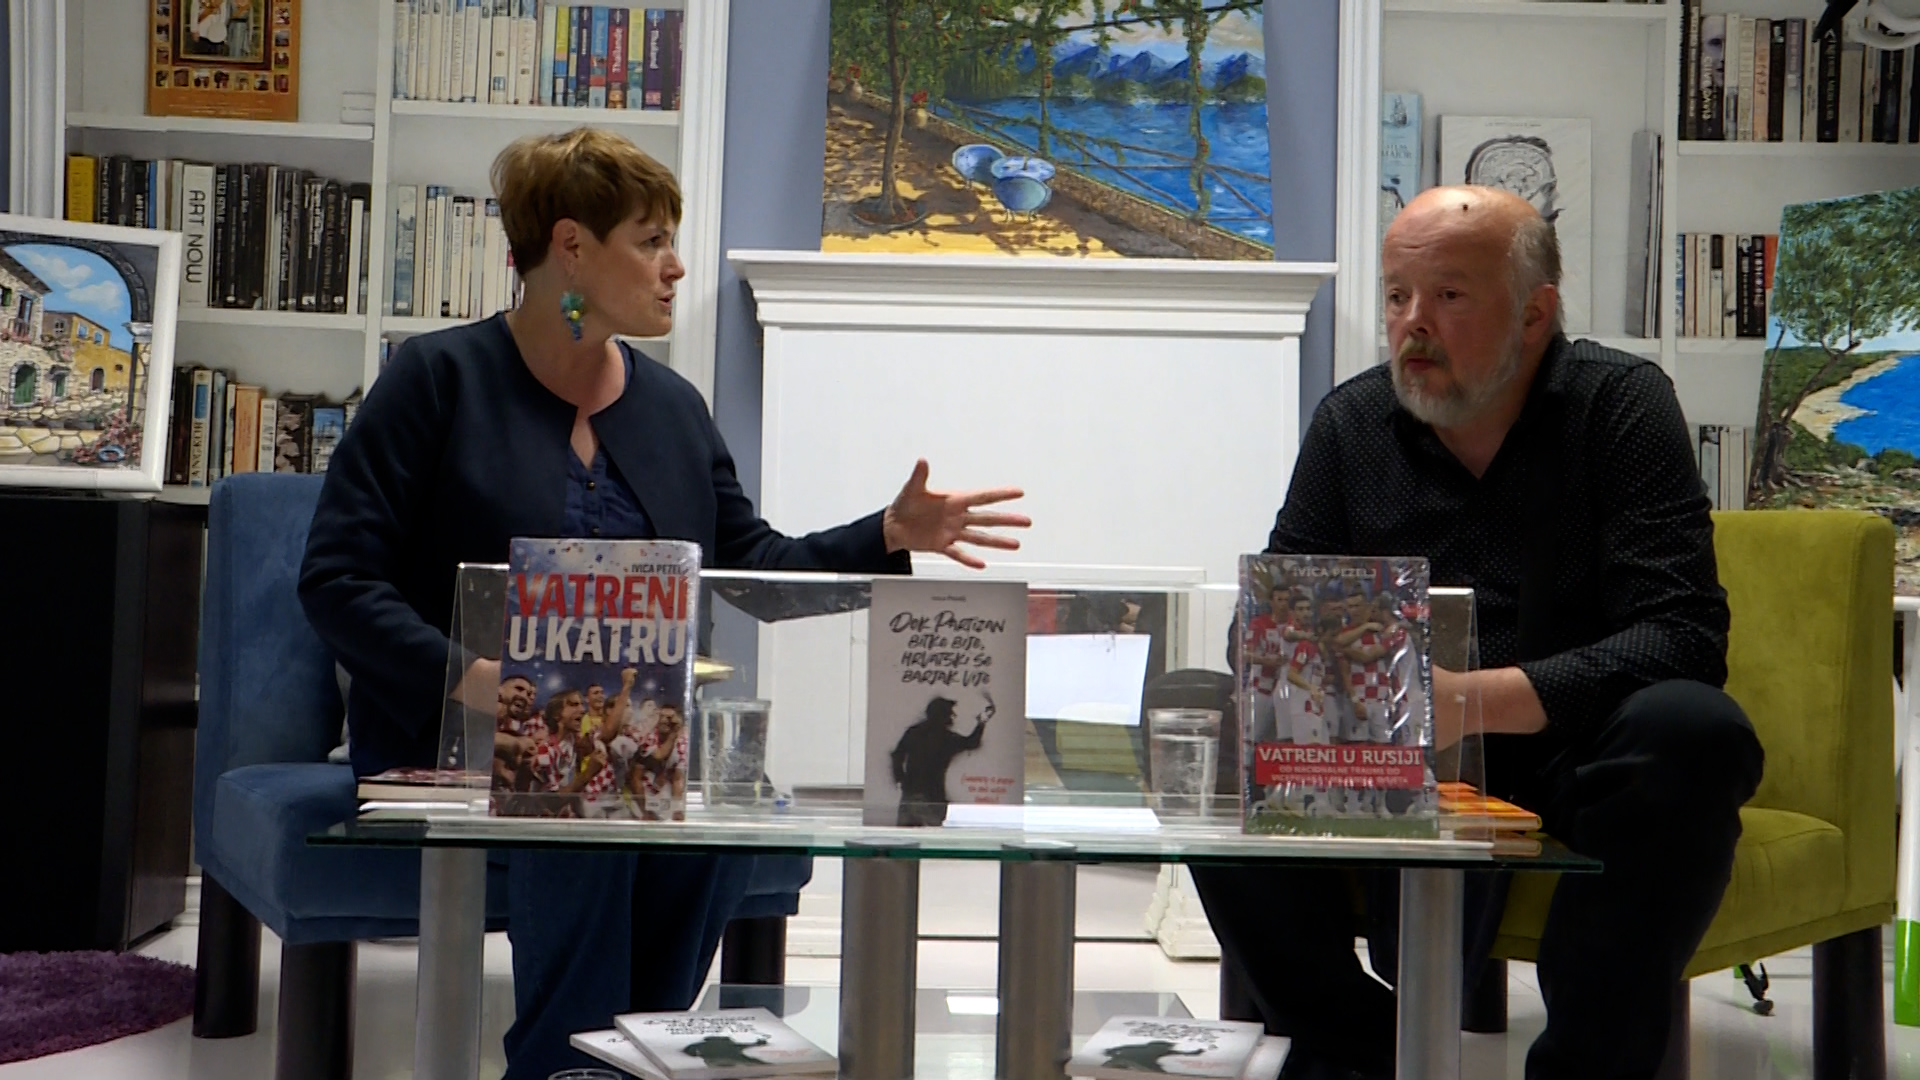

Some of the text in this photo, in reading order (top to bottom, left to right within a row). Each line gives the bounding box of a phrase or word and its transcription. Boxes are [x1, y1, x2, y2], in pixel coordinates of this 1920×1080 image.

[186, 189, 206, 283] ART NOW
[191, 421, 204, 478] ANGKOR
[631, 564, 654, 573] IVICA
[1293, 567, 1377, 578] IVICA PEZELJ
[516, 572, 688, 621] VATRENI
[508, 616, 688, 665] U KATRU
[901, 669, 960, 687] BARJAK
[1258, 747, 1421, 766] VATRENI U RUSIJI
